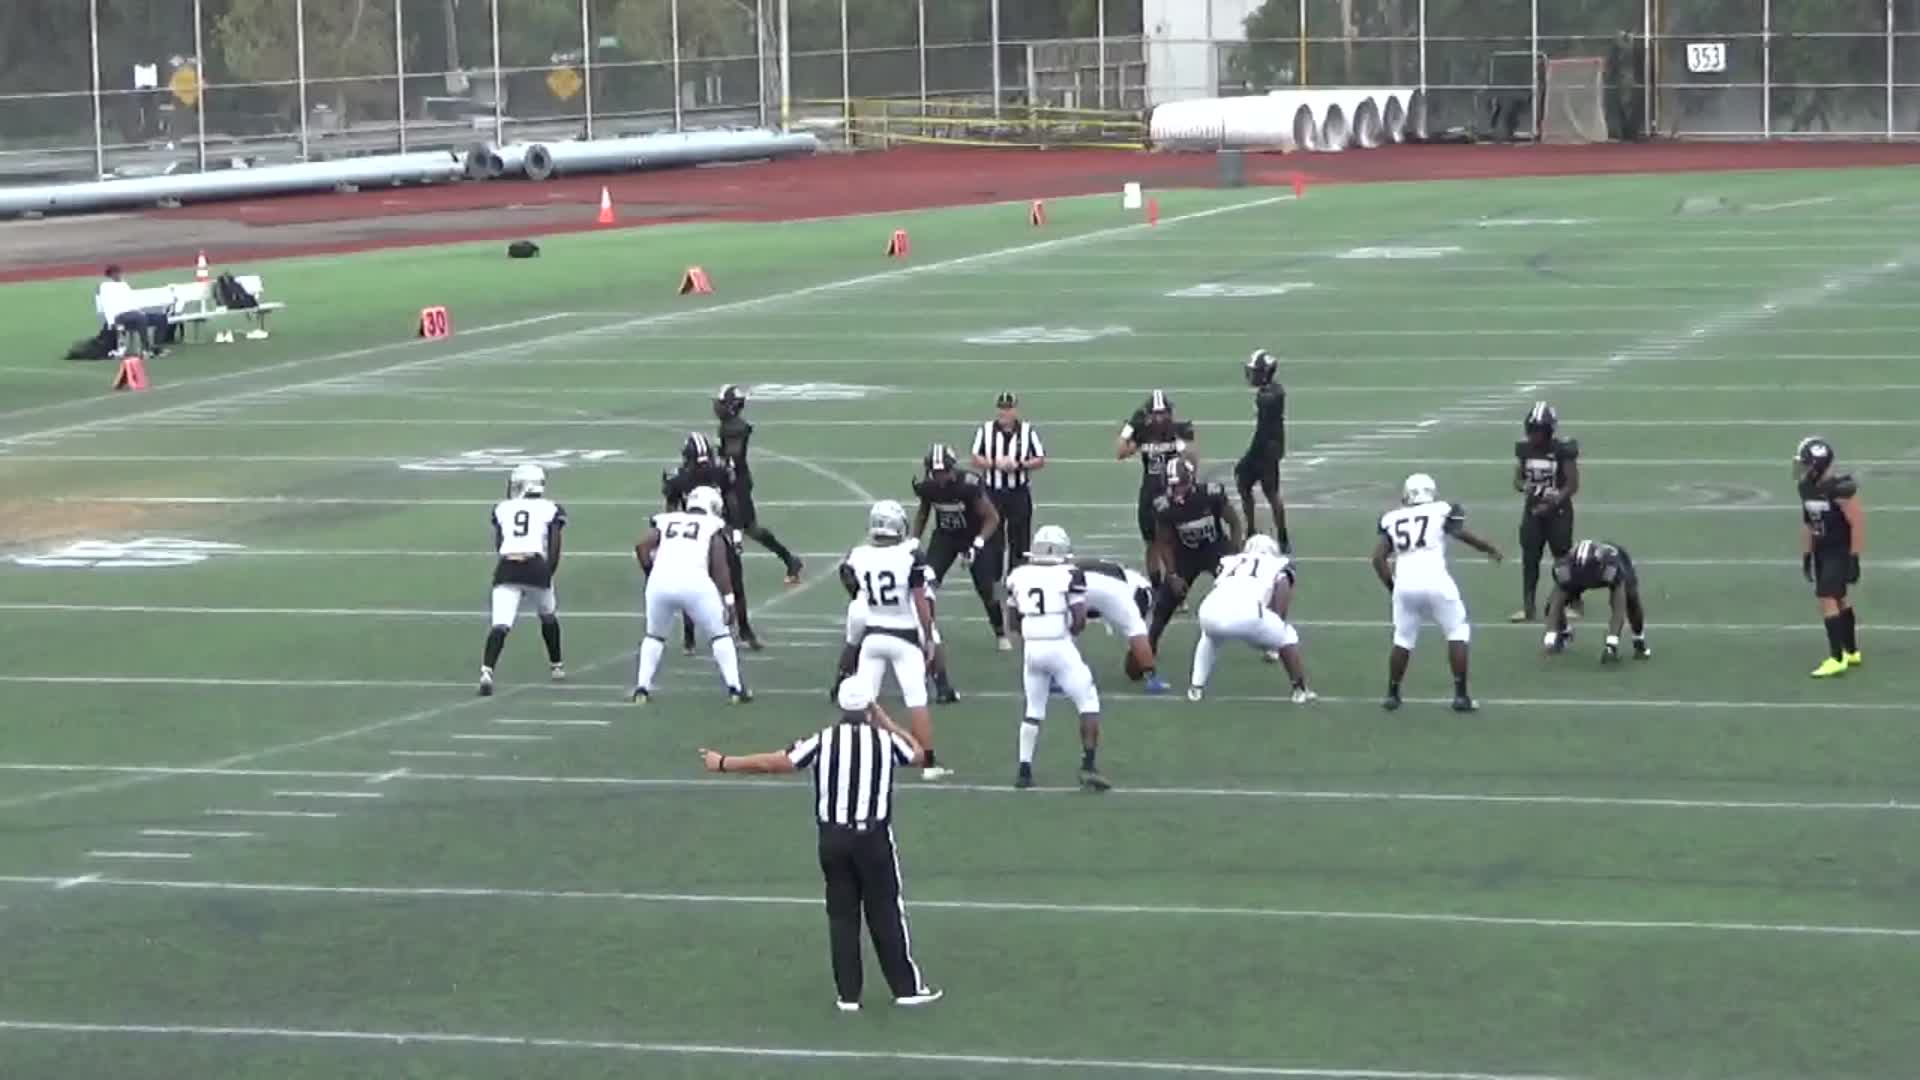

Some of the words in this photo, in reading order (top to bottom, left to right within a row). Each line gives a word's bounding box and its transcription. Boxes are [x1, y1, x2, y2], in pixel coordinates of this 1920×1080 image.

[1692, 46, 1720, 69] 353
[426, 311, 446, 336] 30
[513, 509, 530, 537] 9
[1395, 515, 1429, 551] 57
[864, 570, 899, 606] 12
[1027, 587, 1045, 616] 3
